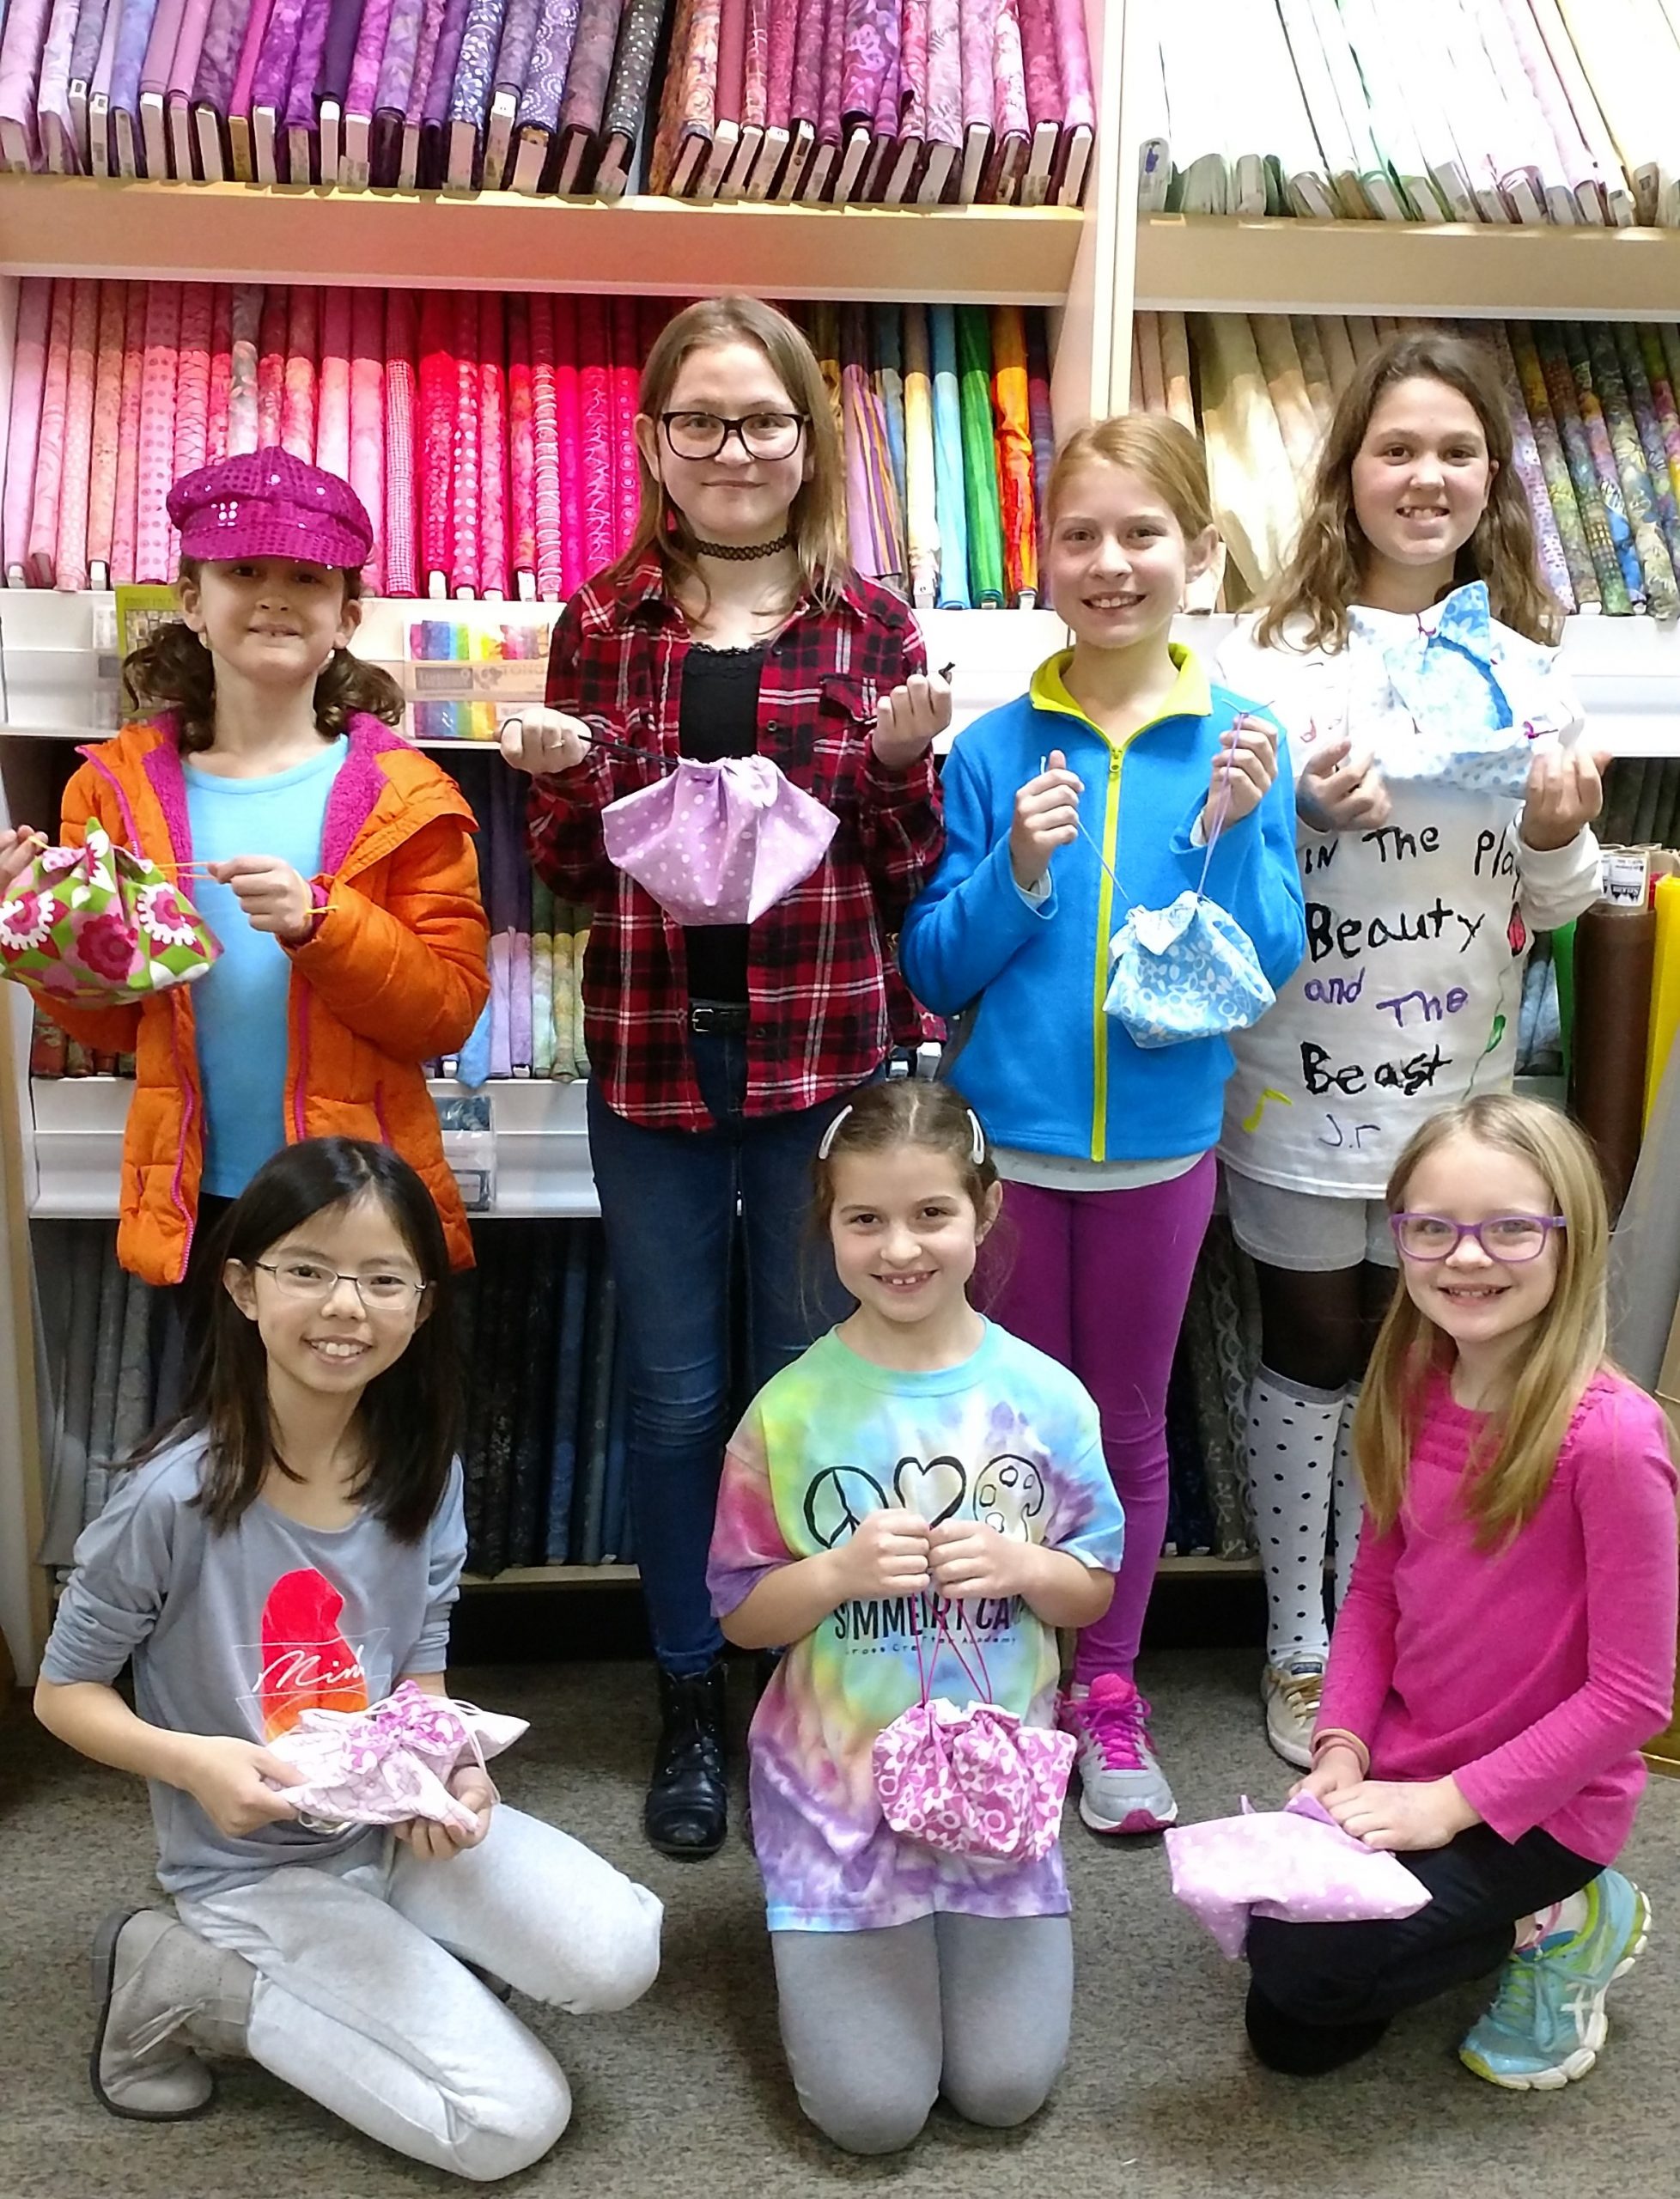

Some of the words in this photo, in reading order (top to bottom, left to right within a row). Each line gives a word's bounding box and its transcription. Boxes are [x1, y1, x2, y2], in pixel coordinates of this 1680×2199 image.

[1363, 825, 1440, 862] The
[1305, 898, 1485, 962] Beauty
[1304, 967, 1365, 1004] and
[1376, 987, 1468, 1026] The
[1300, 1041, 1452, 1096] Beast
